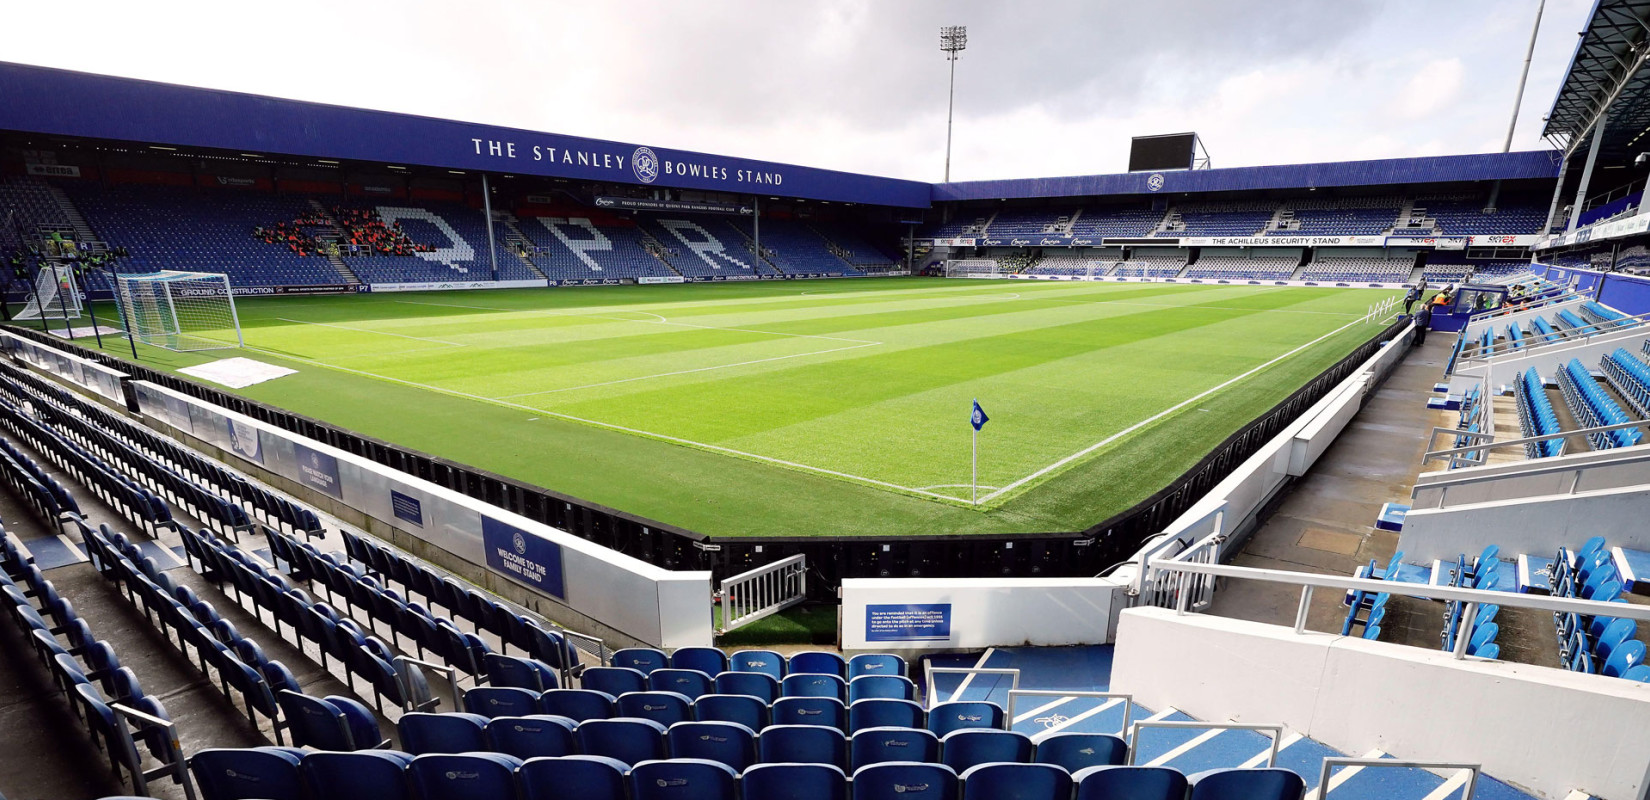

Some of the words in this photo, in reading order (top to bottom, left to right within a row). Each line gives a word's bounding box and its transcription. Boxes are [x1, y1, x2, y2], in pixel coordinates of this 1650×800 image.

[471, 138, 516, 158] THE
[533, 145, 625, 170] STANLEY
[665, 160, 728, 180] BOWLES
[737, 169, 782, 186] STAND
[80, 242, 88, 250] R
[498, 548, 525, 566] WELCOME
[526, 560, 535, 570] TO
[535, 563, 546, 576] THE
[504, 560, 522, 574] FAMILY
[523, 568, 542, 582] STAND
